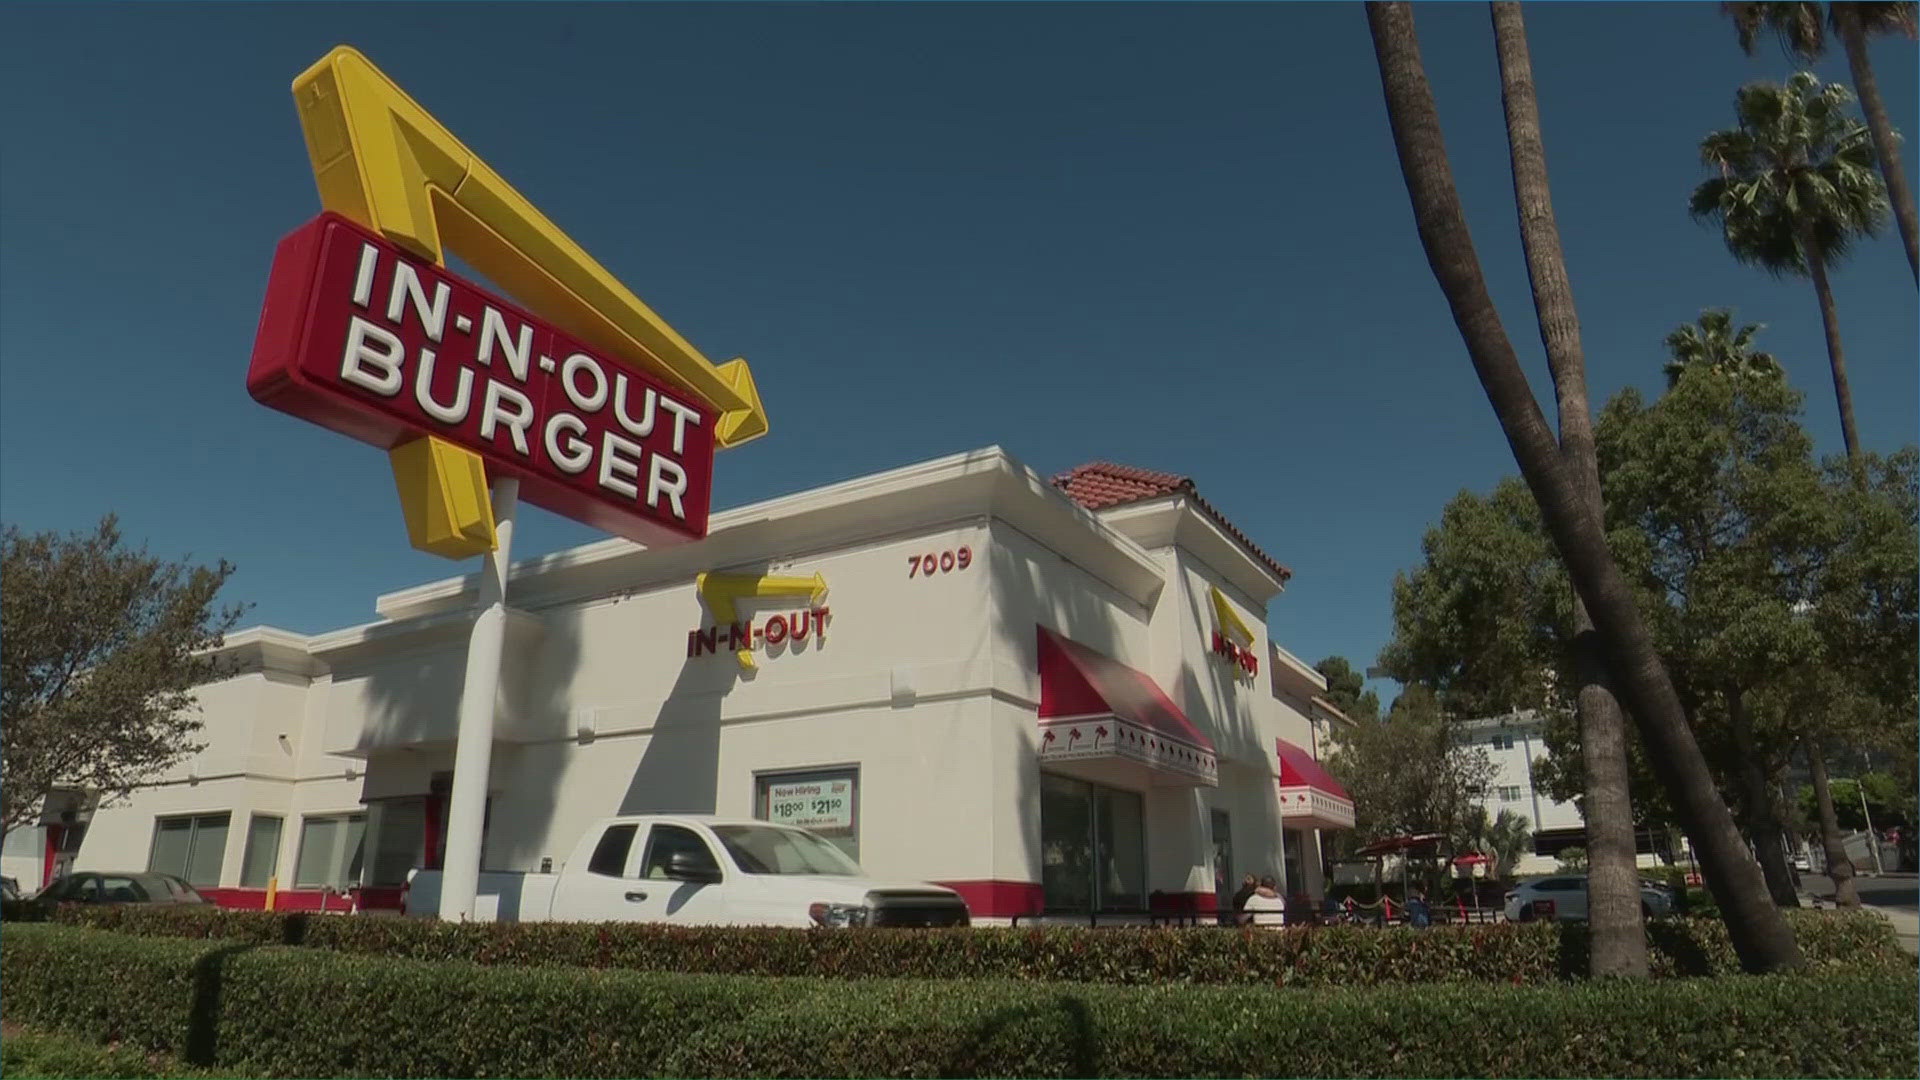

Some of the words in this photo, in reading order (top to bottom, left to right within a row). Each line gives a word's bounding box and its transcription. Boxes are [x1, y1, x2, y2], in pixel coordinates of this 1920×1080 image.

[352, 241, 701, 456] IN-N-OUT
[340, 314, 688, 520] BURGER
[907, 545, 973, 579] 7009
[687, 606, 829, 658] IN-N-OUT
[775, 787, 793, 797] Now
[795, 785, 821, 796] Hiring
